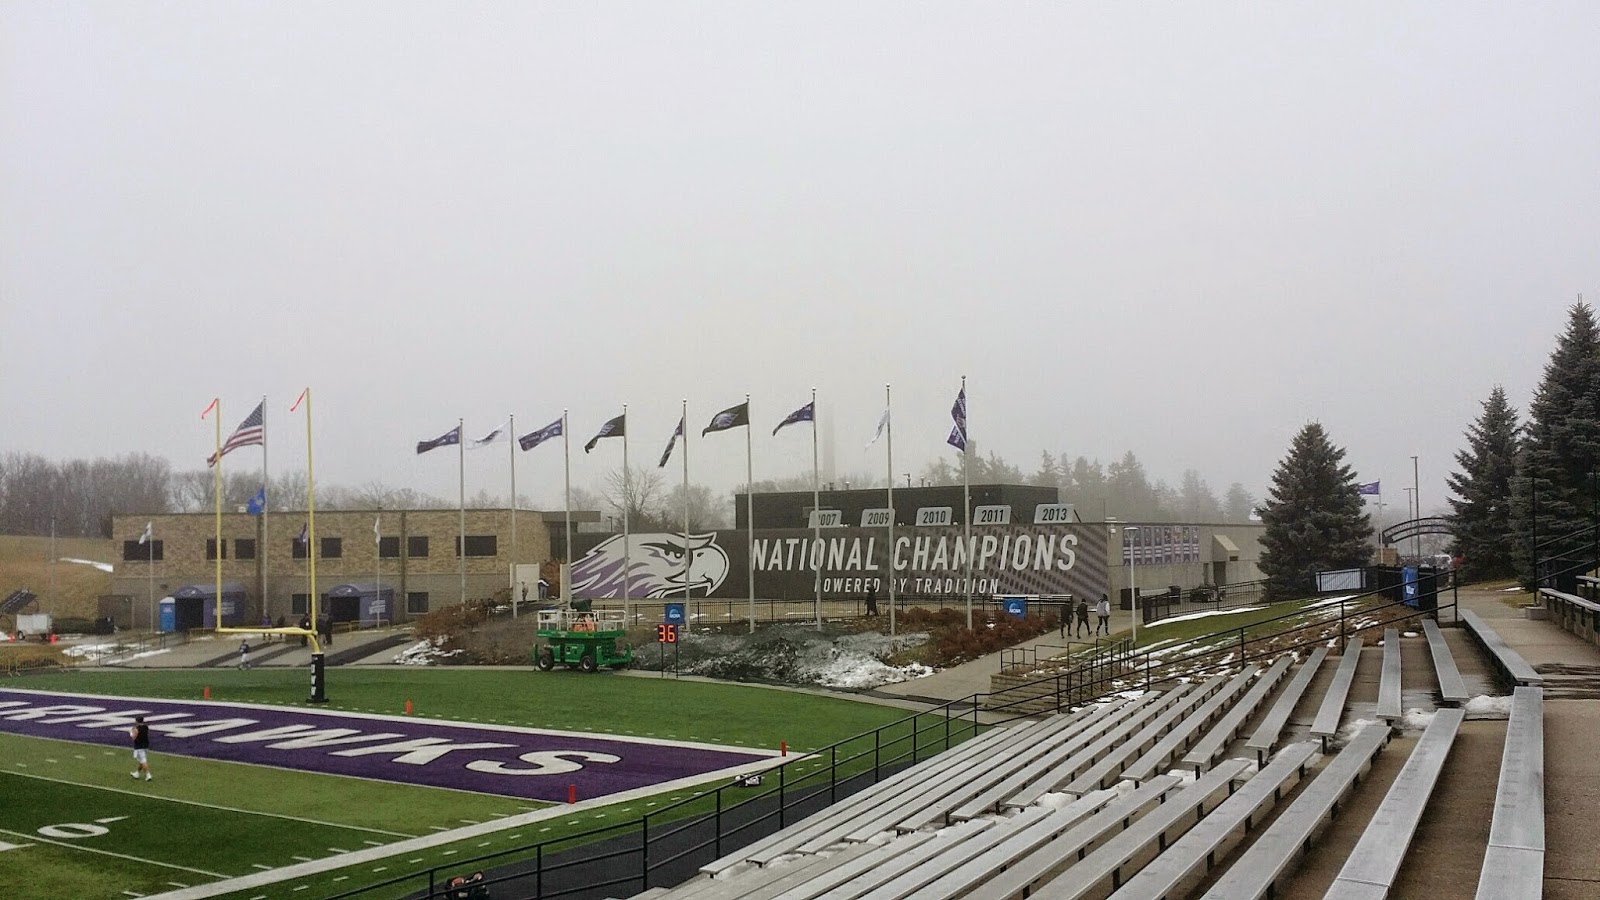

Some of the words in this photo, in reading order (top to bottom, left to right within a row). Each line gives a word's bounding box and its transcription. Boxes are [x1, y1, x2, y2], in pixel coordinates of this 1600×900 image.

[818, 513, 837, 526] 007
[867, 512, 890, 525] 2009
[922, 510, 947, 524] 2010
[980, 509, 1005, 523] 2011
[1041, 508, 1068, 521] 2013
[752, 537, 879, 571] NATIONAL
[893, 533, 1078, 571] CHAMPIONS
[916, 578, 999, 594] TRADITION
[658, 624, 676, 643] 36
